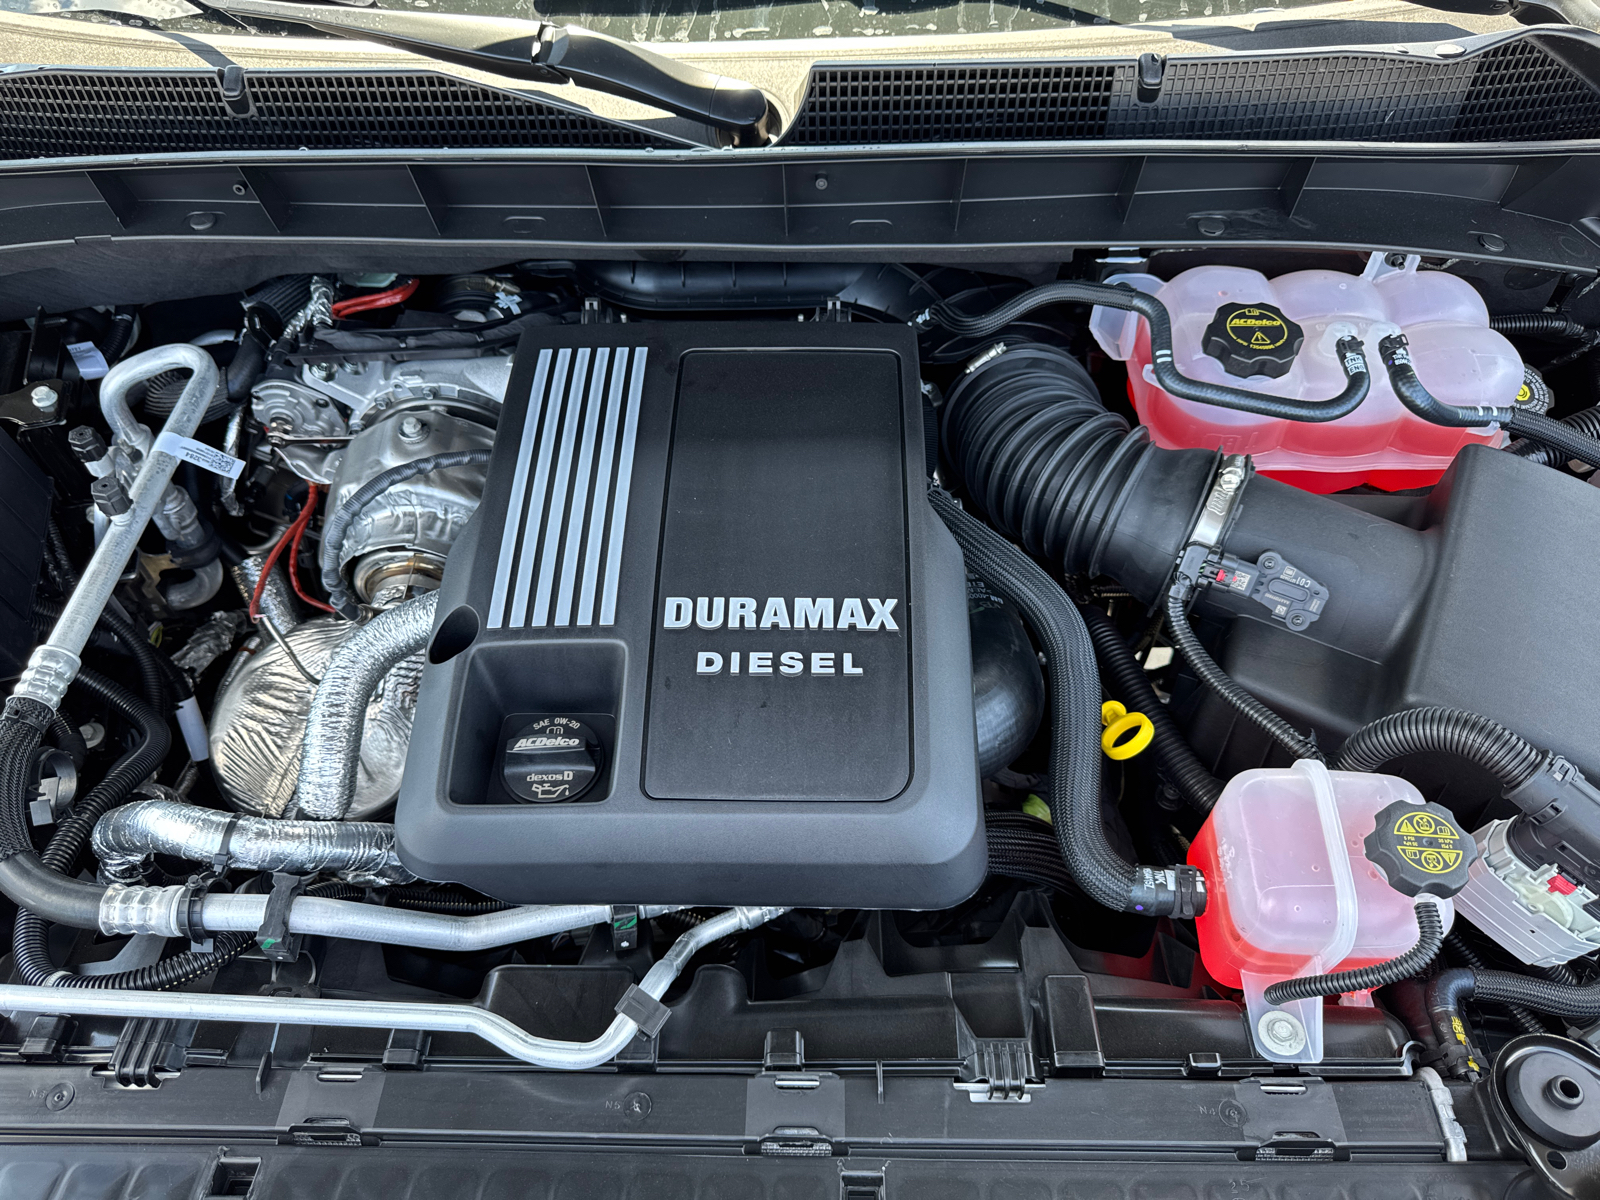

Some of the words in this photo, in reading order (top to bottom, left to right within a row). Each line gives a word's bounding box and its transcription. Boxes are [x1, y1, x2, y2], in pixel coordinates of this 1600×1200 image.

[1230, 318, 1281, 326] ACDelco
[1345, 355, 1363, 366] TNK
[663, 596, 900, 632] DURAMAX
[696, 651, 864, 677] DIESEL
[533, 718, 550, 730] SAE
[554, 717, 581, 730] 0W-20
[513, 737, 580, 749] ACDelco
[1154, 870, 1167, 885] TNK
